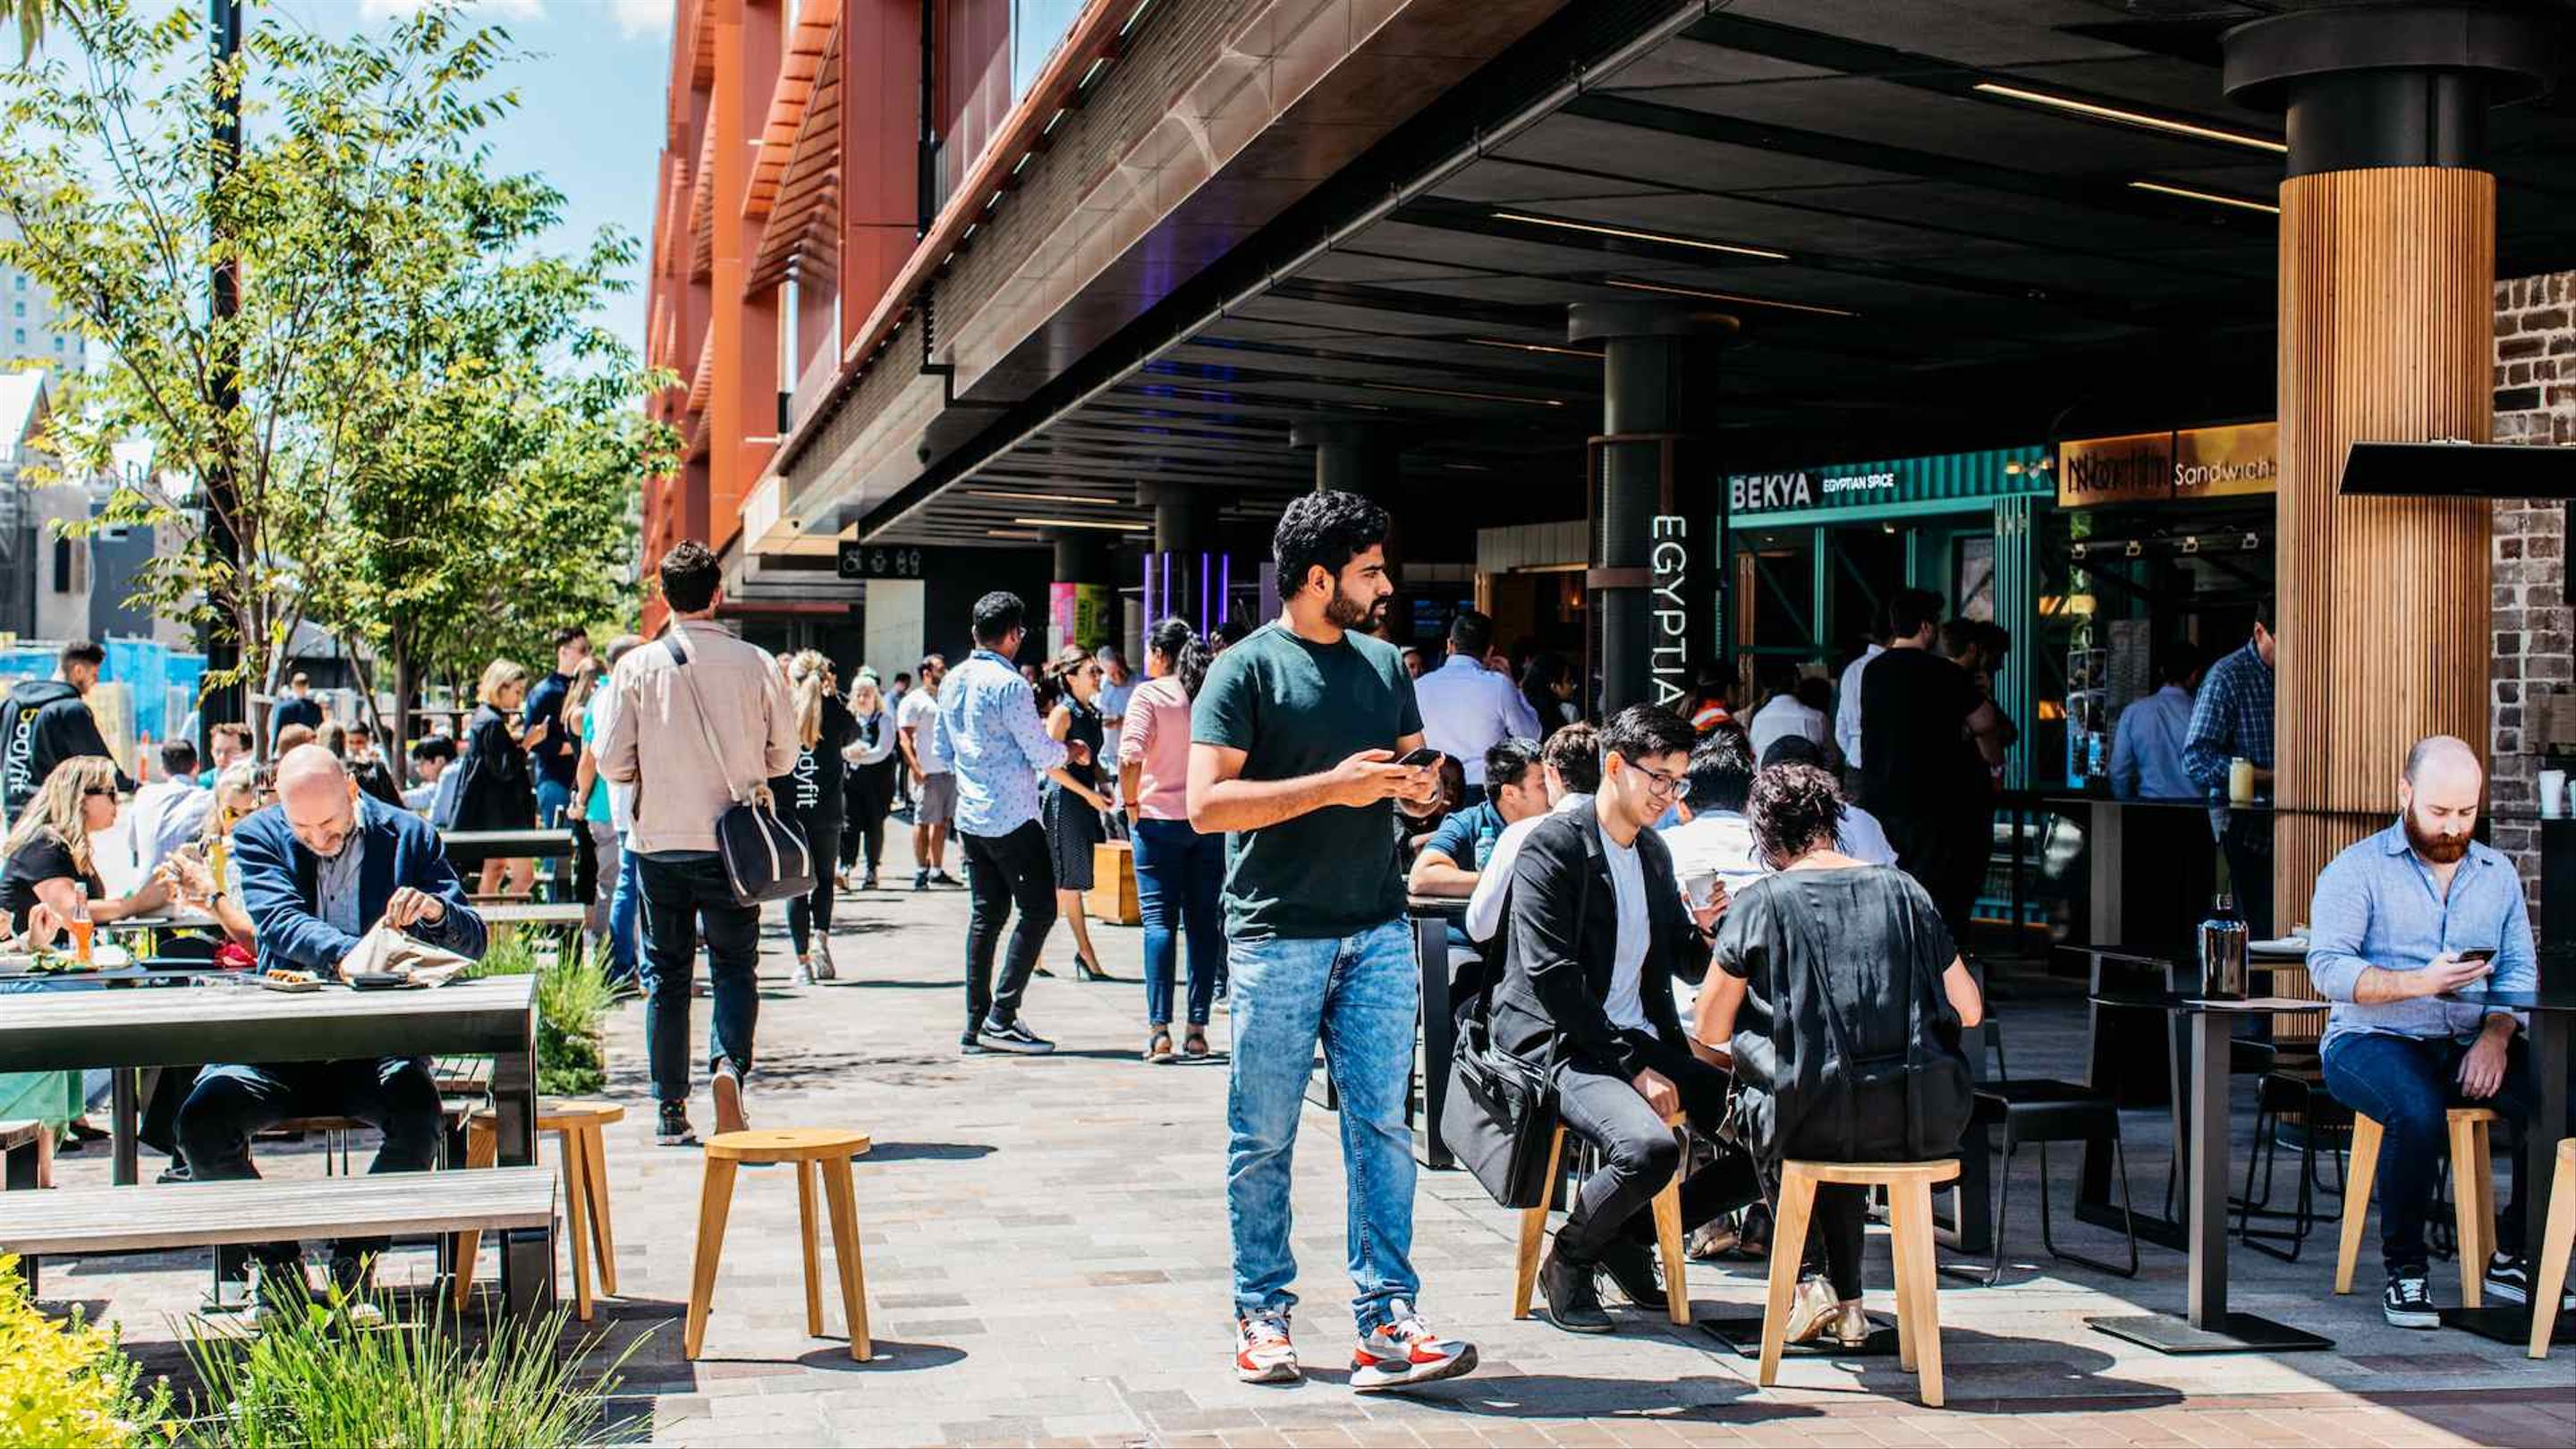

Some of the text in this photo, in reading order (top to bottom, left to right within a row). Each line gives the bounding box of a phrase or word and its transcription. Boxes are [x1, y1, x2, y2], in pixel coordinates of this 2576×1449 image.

[1732, 471, 1812, 510] BEKYA
[1822, 473, 1894, 493] EGYPTIAN SPICE
[1652, 515, 1687, 708] EGYPTIA
[792, 744, 820, 809] odyfit
